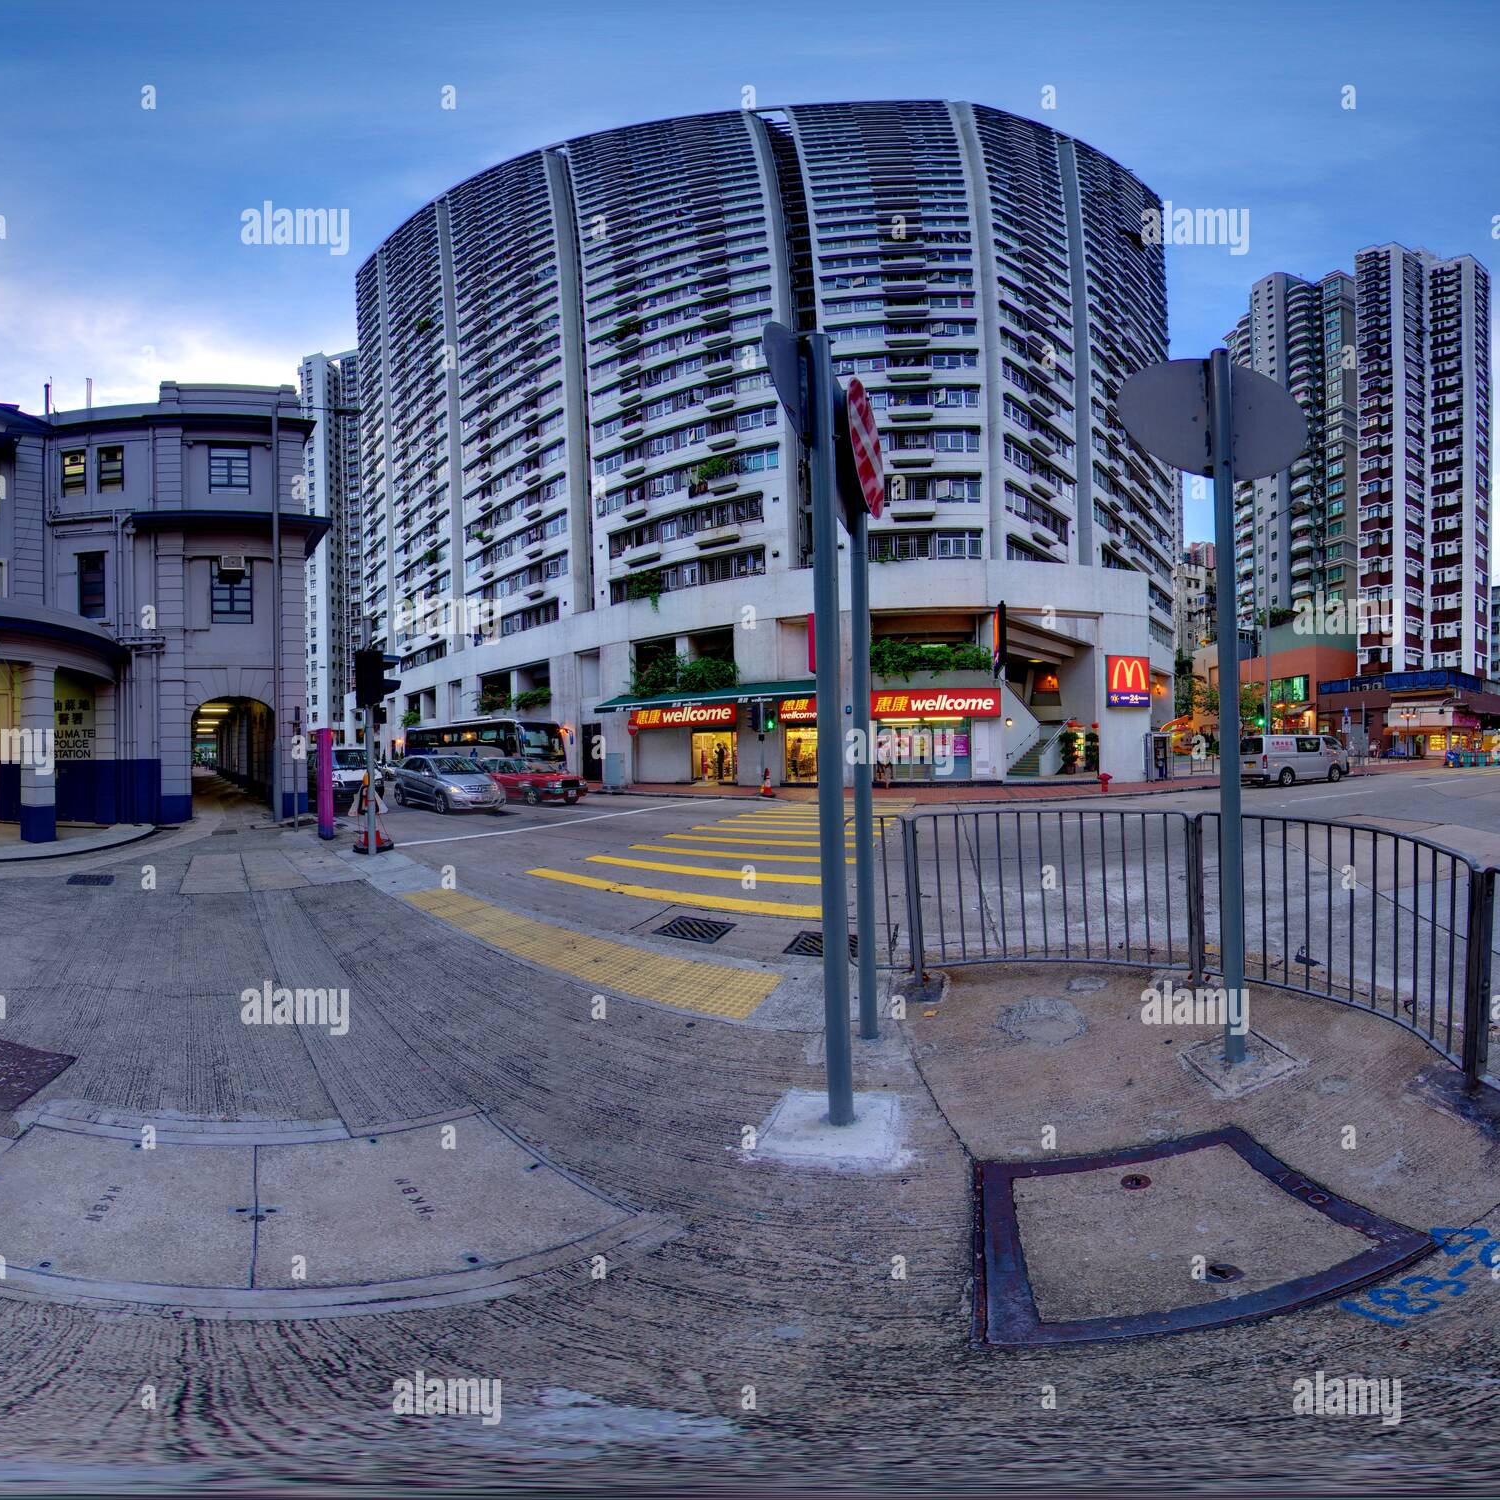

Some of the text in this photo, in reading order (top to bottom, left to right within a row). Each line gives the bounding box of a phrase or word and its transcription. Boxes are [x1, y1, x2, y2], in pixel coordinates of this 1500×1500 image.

[874, 695, 994, 712] 惠康 wellcome
[1130, 694, 1140, 702] 24
[636, 707, 732, 725] 惠康 wellcome
[780, 711, 818, 720] wellcome
[85, 1185, 123, 1223] HKBN
[394, 1178, 435, 1215] HKBN
